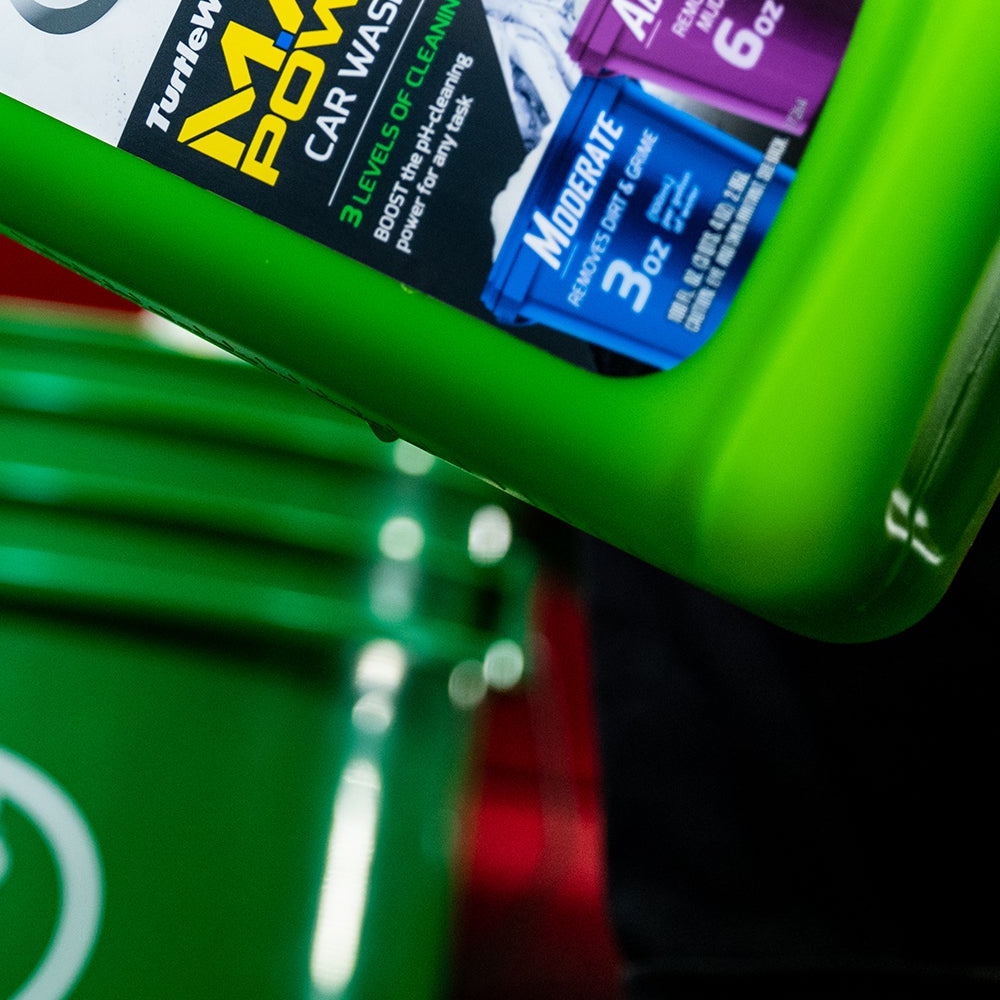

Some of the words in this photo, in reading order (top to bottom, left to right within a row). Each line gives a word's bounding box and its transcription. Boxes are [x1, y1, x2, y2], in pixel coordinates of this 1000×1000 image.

[712, 18, 764, 70] 6
[304, 87, 357, 161] CAR
[339, 205, 363, 228] 3
[352, 122, 400, 205] LEVELS
[390, 88, 412, 121] OF
[373, 181, 408, 242] BOOST
[400, 152, 423, 181] the
[415, 52, 473, 154] pH-cleaning
[625, 129, 658, 179] GRIME
[396, 197, 425, 254] power
[416, 167, 438, 195] for
[432, 133, 458, 167] any
[446, 95, 474, 132] task
[522, 109, 624, 271] MODERATE
[618, 180, 634, 195] &
[600, 192, 626, 233] DIRT
[567, 232, 610, 307] REMOVES
[601, 259, 653, 313] 3
